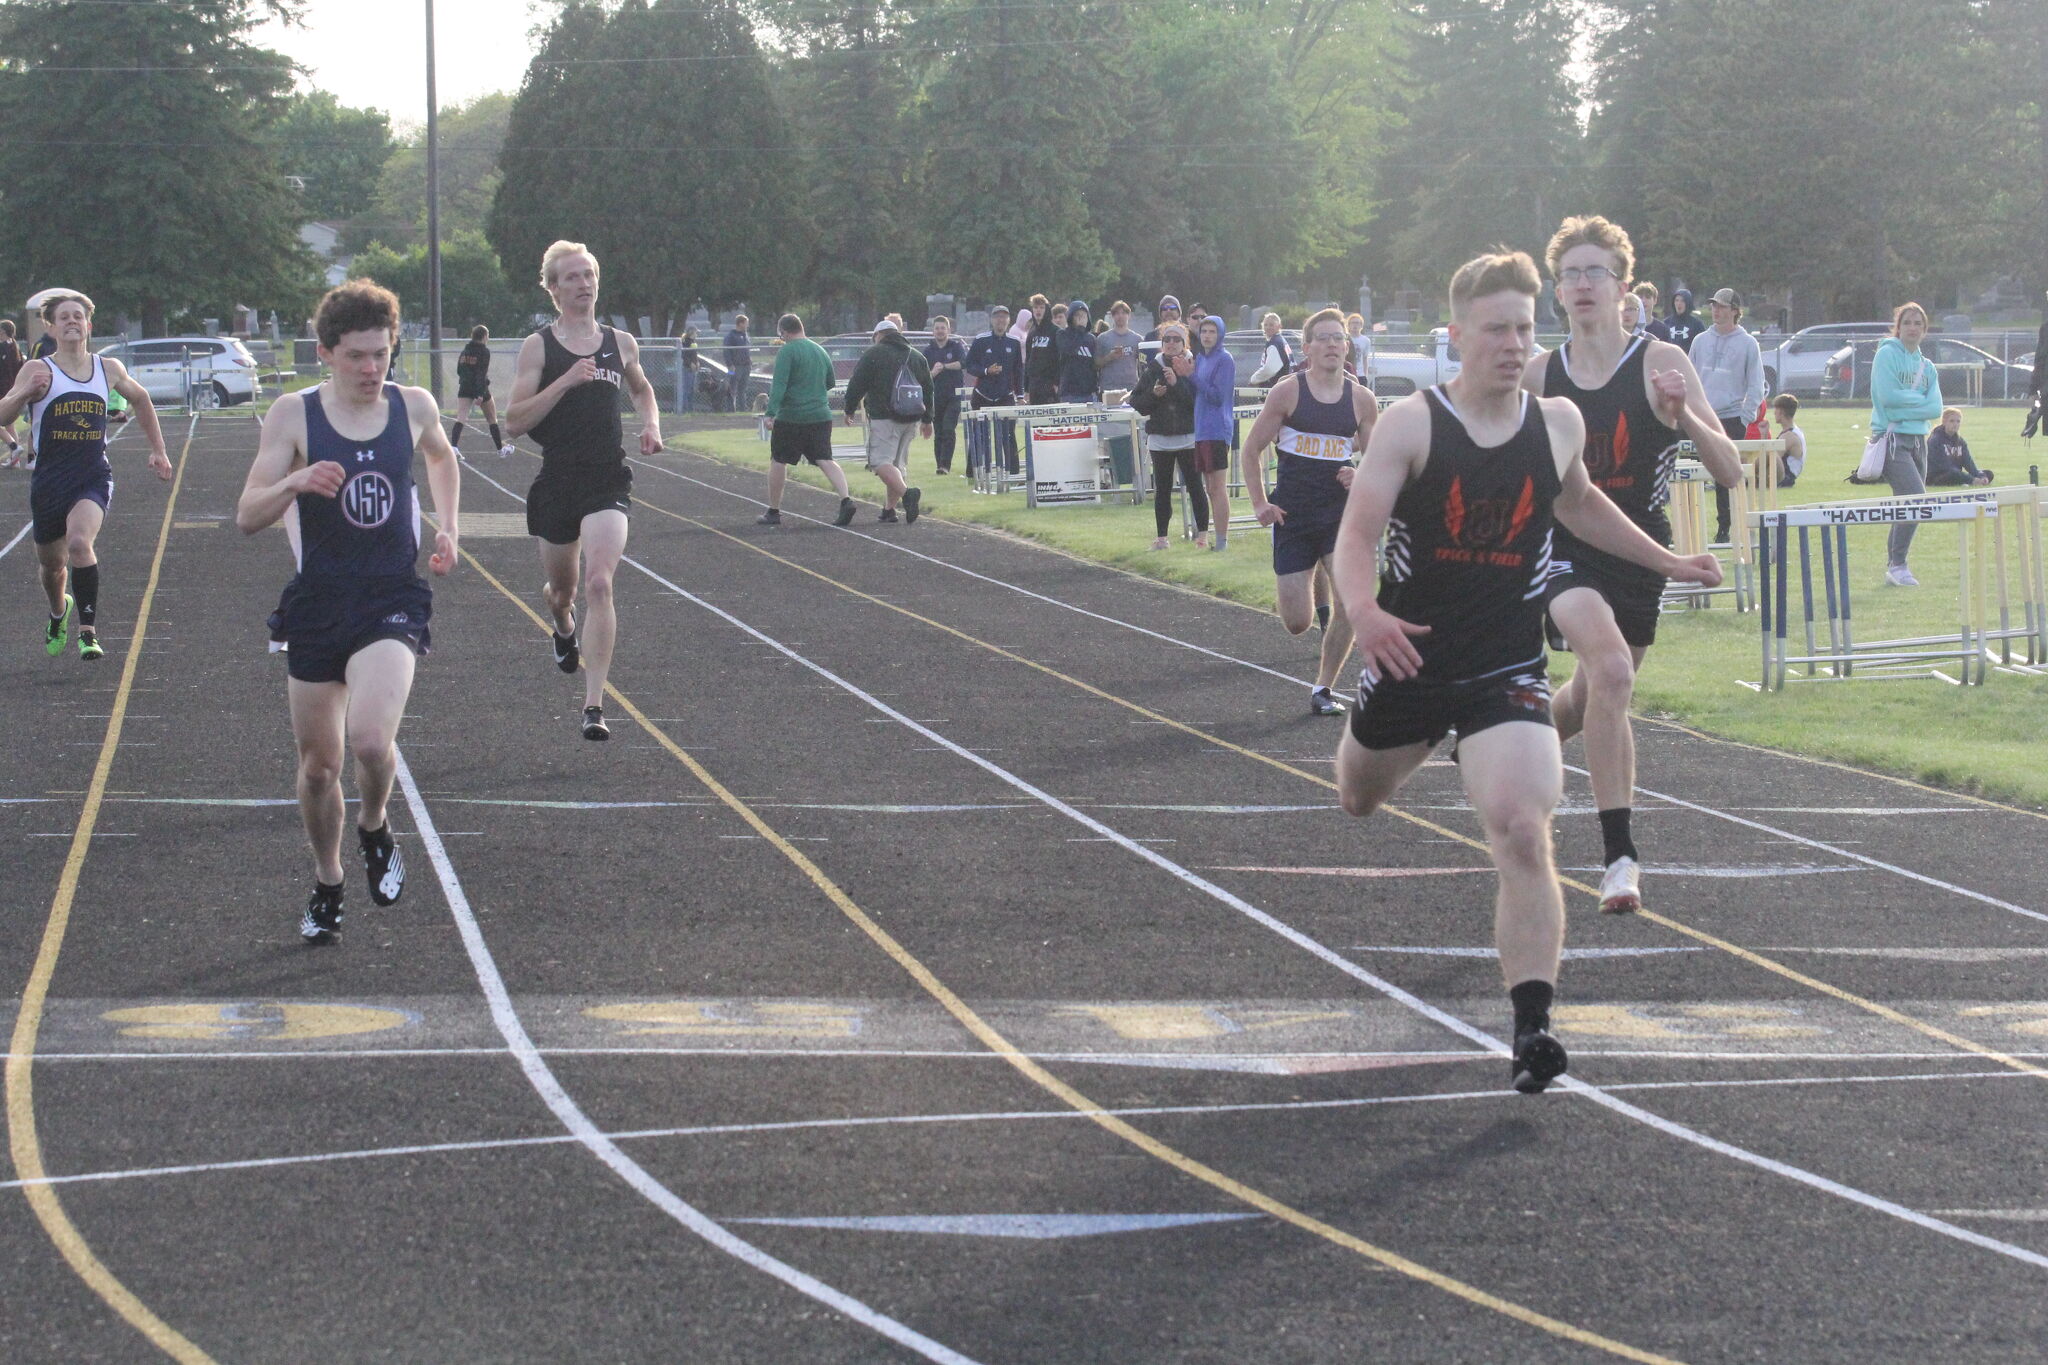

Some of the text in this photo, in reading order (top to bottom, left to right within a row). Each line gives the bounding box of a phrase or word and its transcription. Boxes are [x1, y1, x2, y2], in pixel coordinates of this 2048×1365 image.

[54, 400, 104, 416] HATCHETS
[1049, 414, 1112, 425] "HATCHETS"
[52, 430, 77, 440] TRACK
[86, 431, 102, 440] FIELD
[1294, 434, 1345, 458] BAD AXE
[343, 473, 393, 527] USA
[1822, 506, 1941, 523] "HATCHETS"
